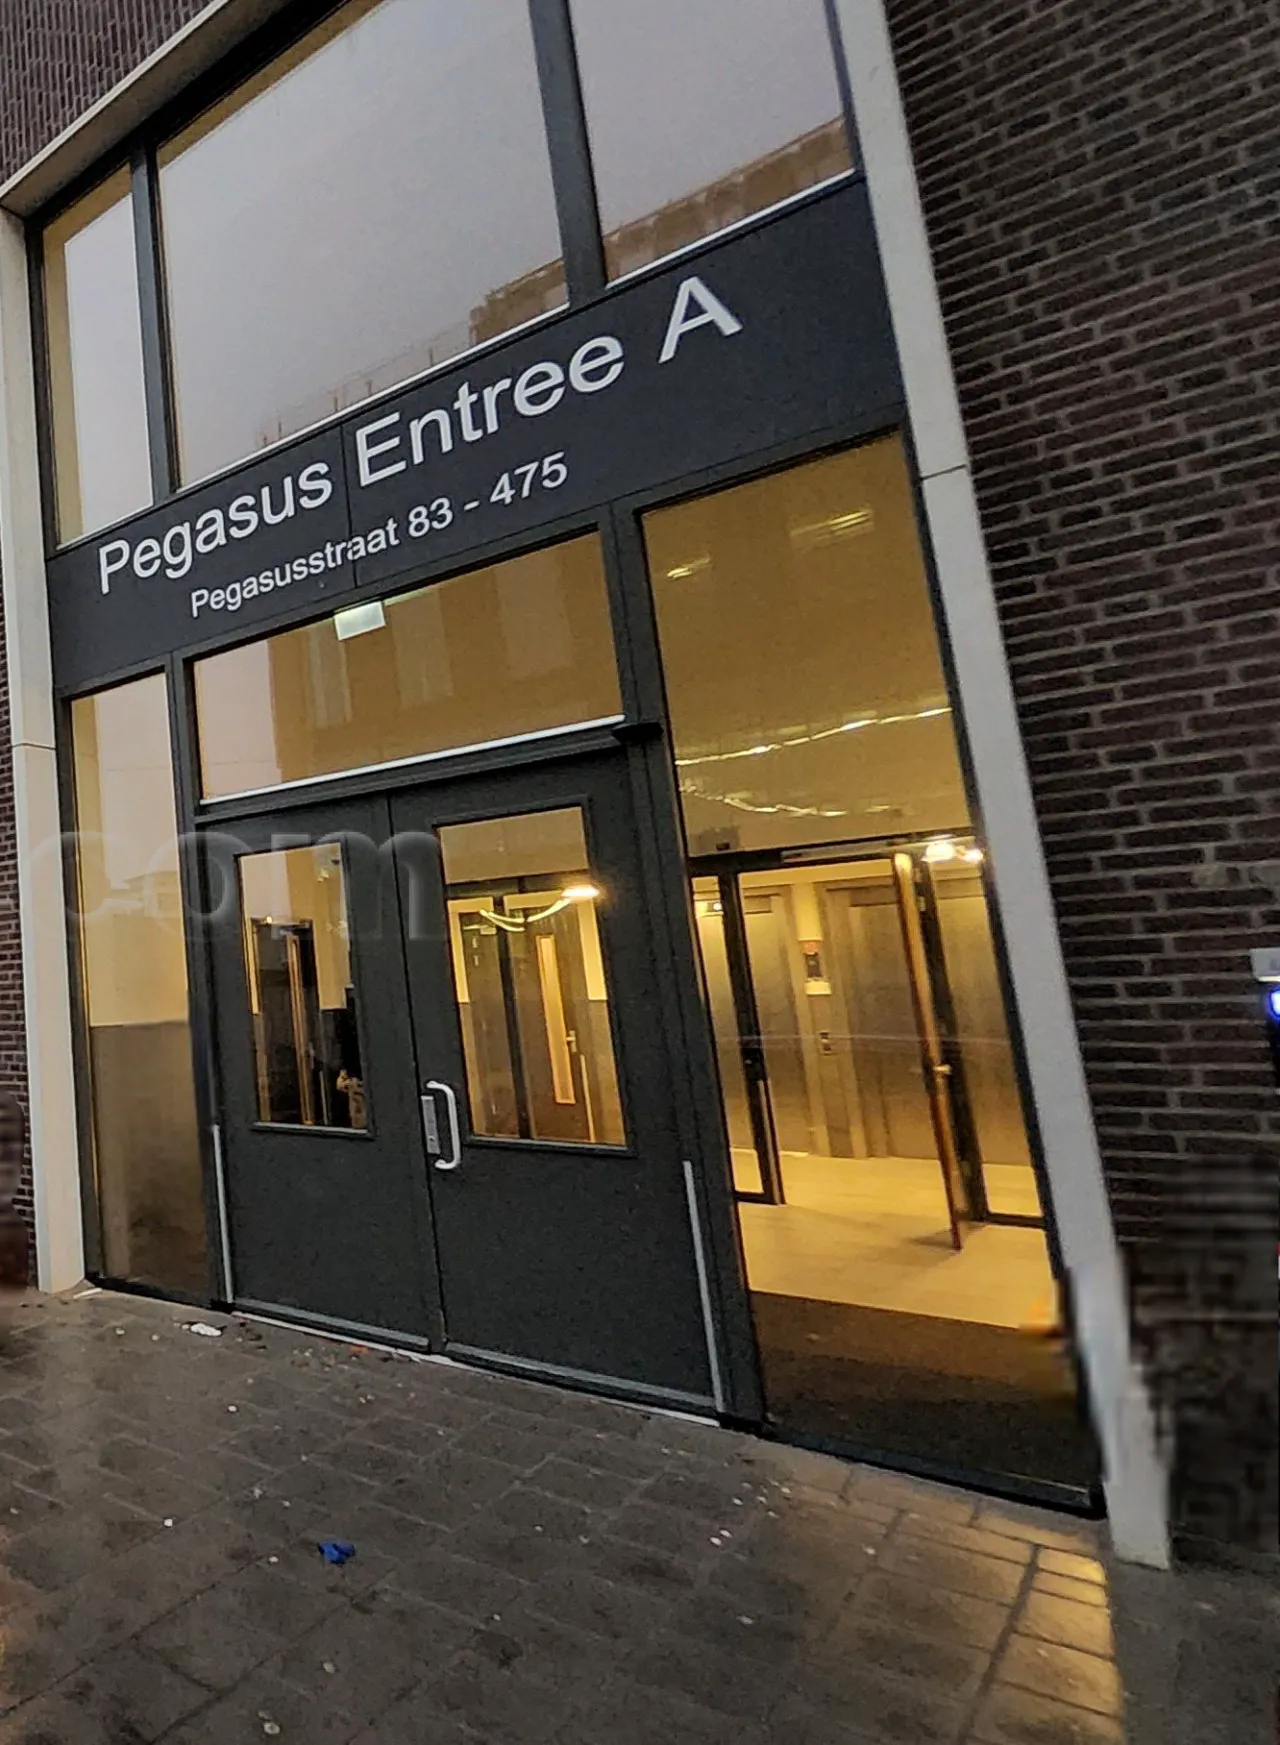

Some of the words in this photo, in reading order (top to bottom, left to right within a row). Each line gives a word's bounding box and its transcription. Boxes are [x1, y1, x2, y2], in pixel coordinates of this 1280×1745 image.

[98, 462, 333, 594] Pegasus
[355, 335, 624, 487] Entree
[659, 276, 743, 363] A
[191, 519, 400, 617] Pegasusstraat
[408, 498, 454, 538] 83
[489, 452, 569, 506] 475
